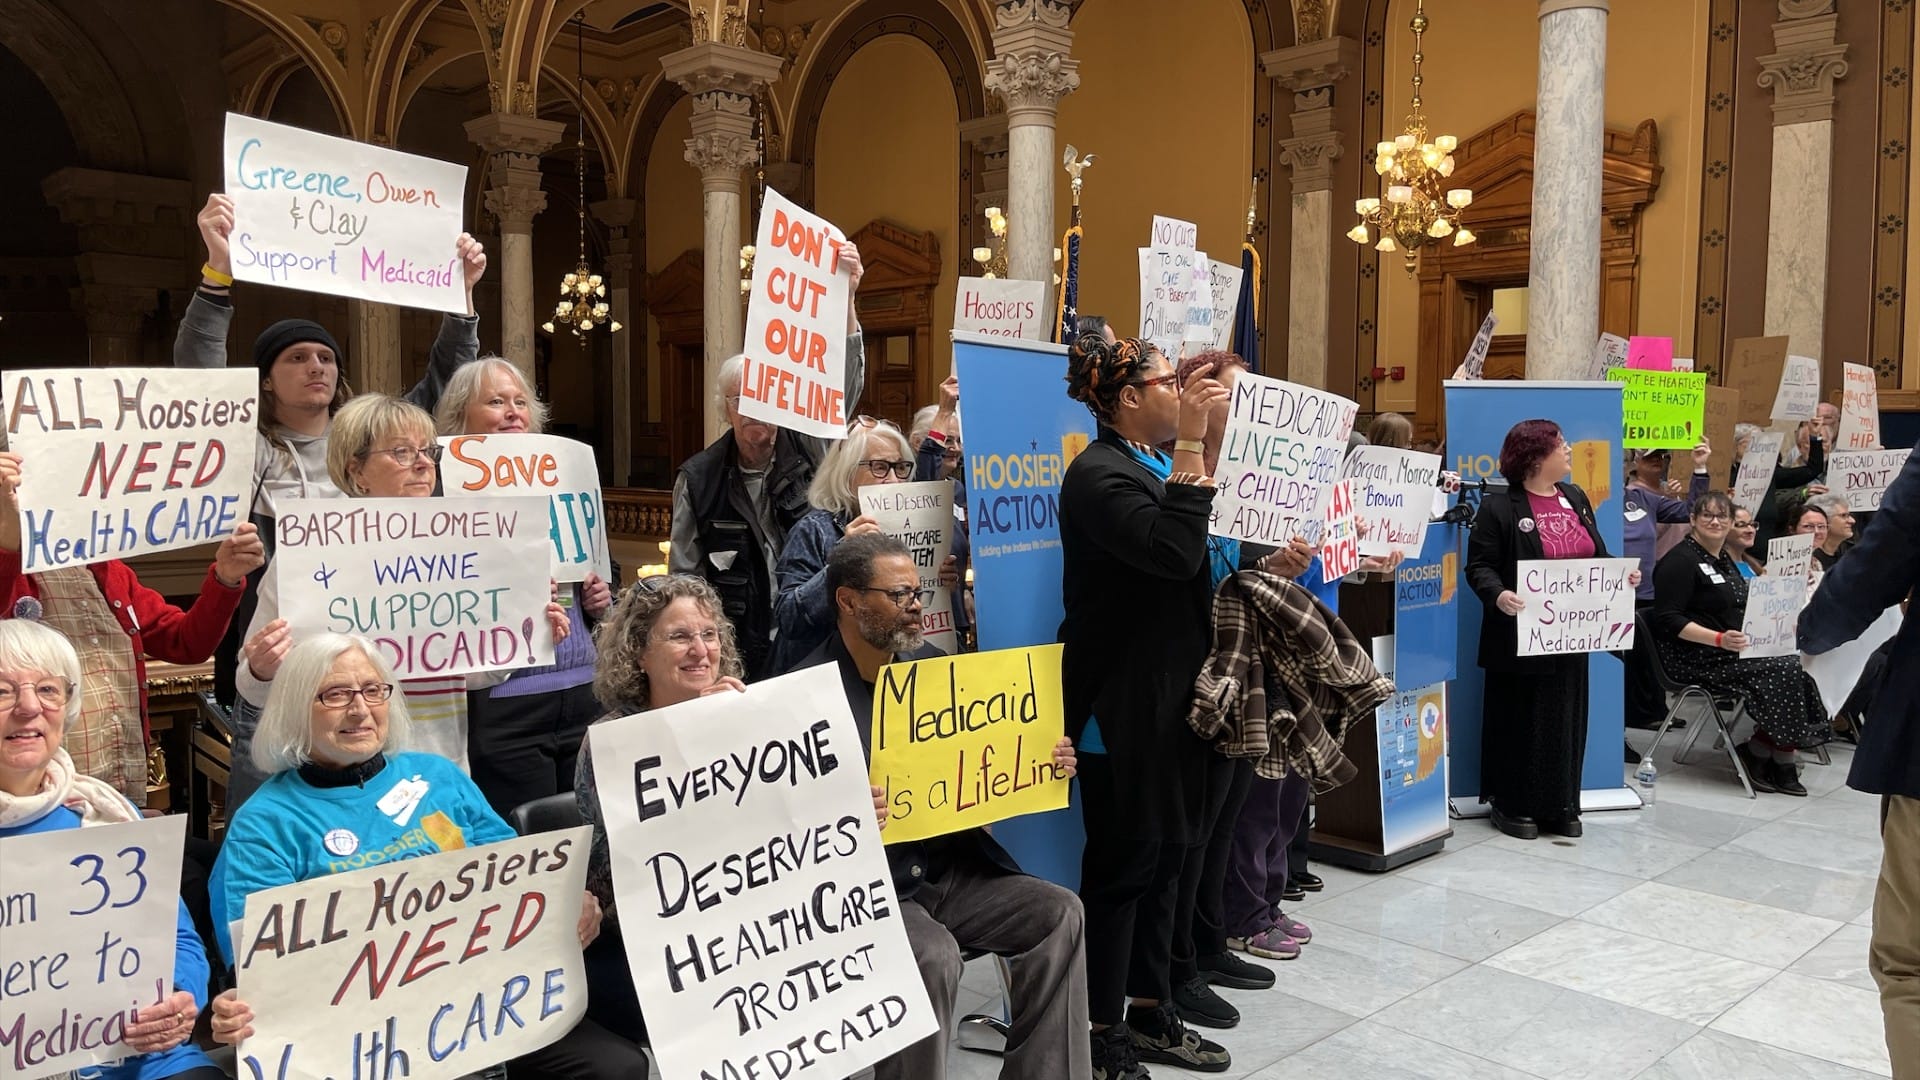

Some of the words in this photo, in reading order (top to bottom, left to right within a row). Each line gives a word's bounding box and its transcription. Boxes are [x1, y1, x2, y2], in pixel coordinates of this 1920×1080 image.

[238, 139, 362, 203] Greene,
[366, 172, 440, 208] Owen
[309, 200, 367, 246] Clay
[771, 209, 845, 275] DON'T
[1154, 222, 1171, 245] NO
[236, 233, 337, 281] Support
[361, 247, 456, 288] Medicaid
[767, 267, 827, 318] CUT
[964, 291, 1034, 320] Hoosiers
[765, 319, 827, 374] OUR
[742, 358, 844, 426] LIFELINE
[1622, 390, 1648, 401] ON'T
[1652, 391, 1663, 403] BE
[1666, 393, 1699, 408] HASTY
[1644, 375, 1655, 386] BE
[8, 376, 103, 434] ALL
[114, 377, 256, 431] Hoosiers
[1234, 381, 1339, 440] MEDICAID
[1623, 410, 1649, 420] TECT
[1228, 429, 1305, 477] LIVES
[1849, 432, 1875, 448] HIP
[78, 439, 226, 499] NEED
[450, 436, 559, 491] Save
[972, 454, 1063, 490] HOOSIER
[1343, 450, 1393, 491] Morgan,
[1396, 456, 1435, 487] Monroe
[1832, 455, 1874, 470] MEDICAID
[1881, 453, 1908, 466] CUTS
[1846, 469, 1891, 489] DON'T
[867, 494, 891, 511] WE
[895, 492, 942, 511] DESERVE
[1237, 472, 1322, 514] CHILDREN
[1366, 484, 1403, 507] Brown
[278, 507, 518, 547] BARTHOLOMEW
[904, 517, 911, 529] A
[977, 493, 1061, 536] ACTION
[1229, 505, 1300, 544] ADULTS
[1377, 517, 1421, 545] Medicaid
[884, 529, 942, 547] THCARE
[912, 548, 935, 567] TEM
[1323, 536, 1358, 581] RICH
[1769, 540, 1784, 561] ALL
[374, 552, 480, 586] WAYNE
[1399, 564, 1442, 583] HOOSIER
[1526, 569, 1574, 595] Clark
[1589, 567, 1625, 601] Floyd
[328, 587, 511, 634] SUPPORT
[1398, 581, 1441, 602] ACTION
[922, 610, 950, 631] OFIT
[1539, 600, 1610, 629] Support
[374, 616, 536, 674] DICAID!
[1528, 622, 1634, 652] Medicaid!!
[880, 653, 1038, 750] Medicaid
[634, 719, 839, 822] EVERYONE
[928, 779, 948, 810] a
[70, 846, 147, 916] 33
[645, 816, 861, 919] DESERVES
[242, 890, 348, 969] ALL
[366, 839, 572, 931] Hoosiers
[0, 952, 70, 998] ere
[96, 931, 140, 984] to
[331, 891, 546, 1006] NEED
[713, 943, 875, 1037] PROTECT
[428, 967, 565, 1062] CARE
